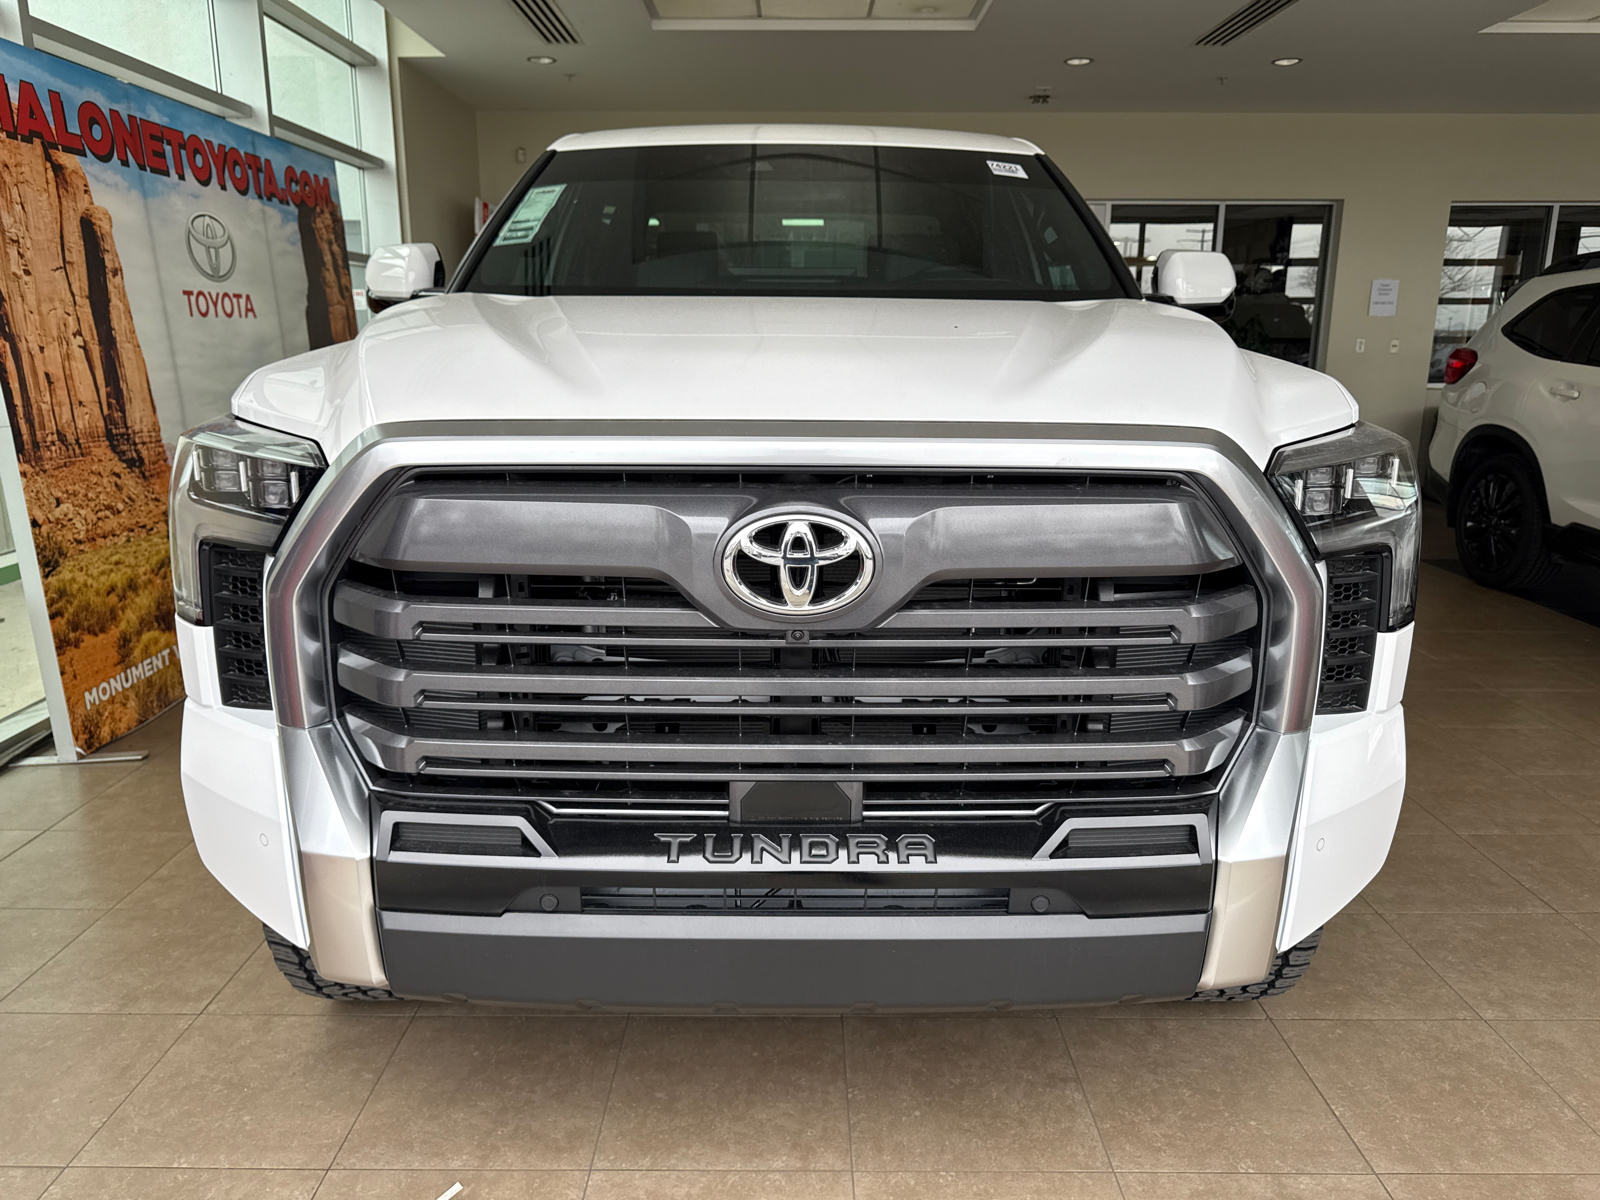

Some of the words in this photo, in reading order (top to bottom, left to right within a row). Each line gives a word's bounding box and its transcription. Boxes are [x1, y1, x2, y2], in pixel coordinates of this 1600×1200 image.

[182, 289, 257, 319] TOYOTA
[84, 648, 170, 710] MONUMENT
[653, 833, 938, 865] TUNDRA
